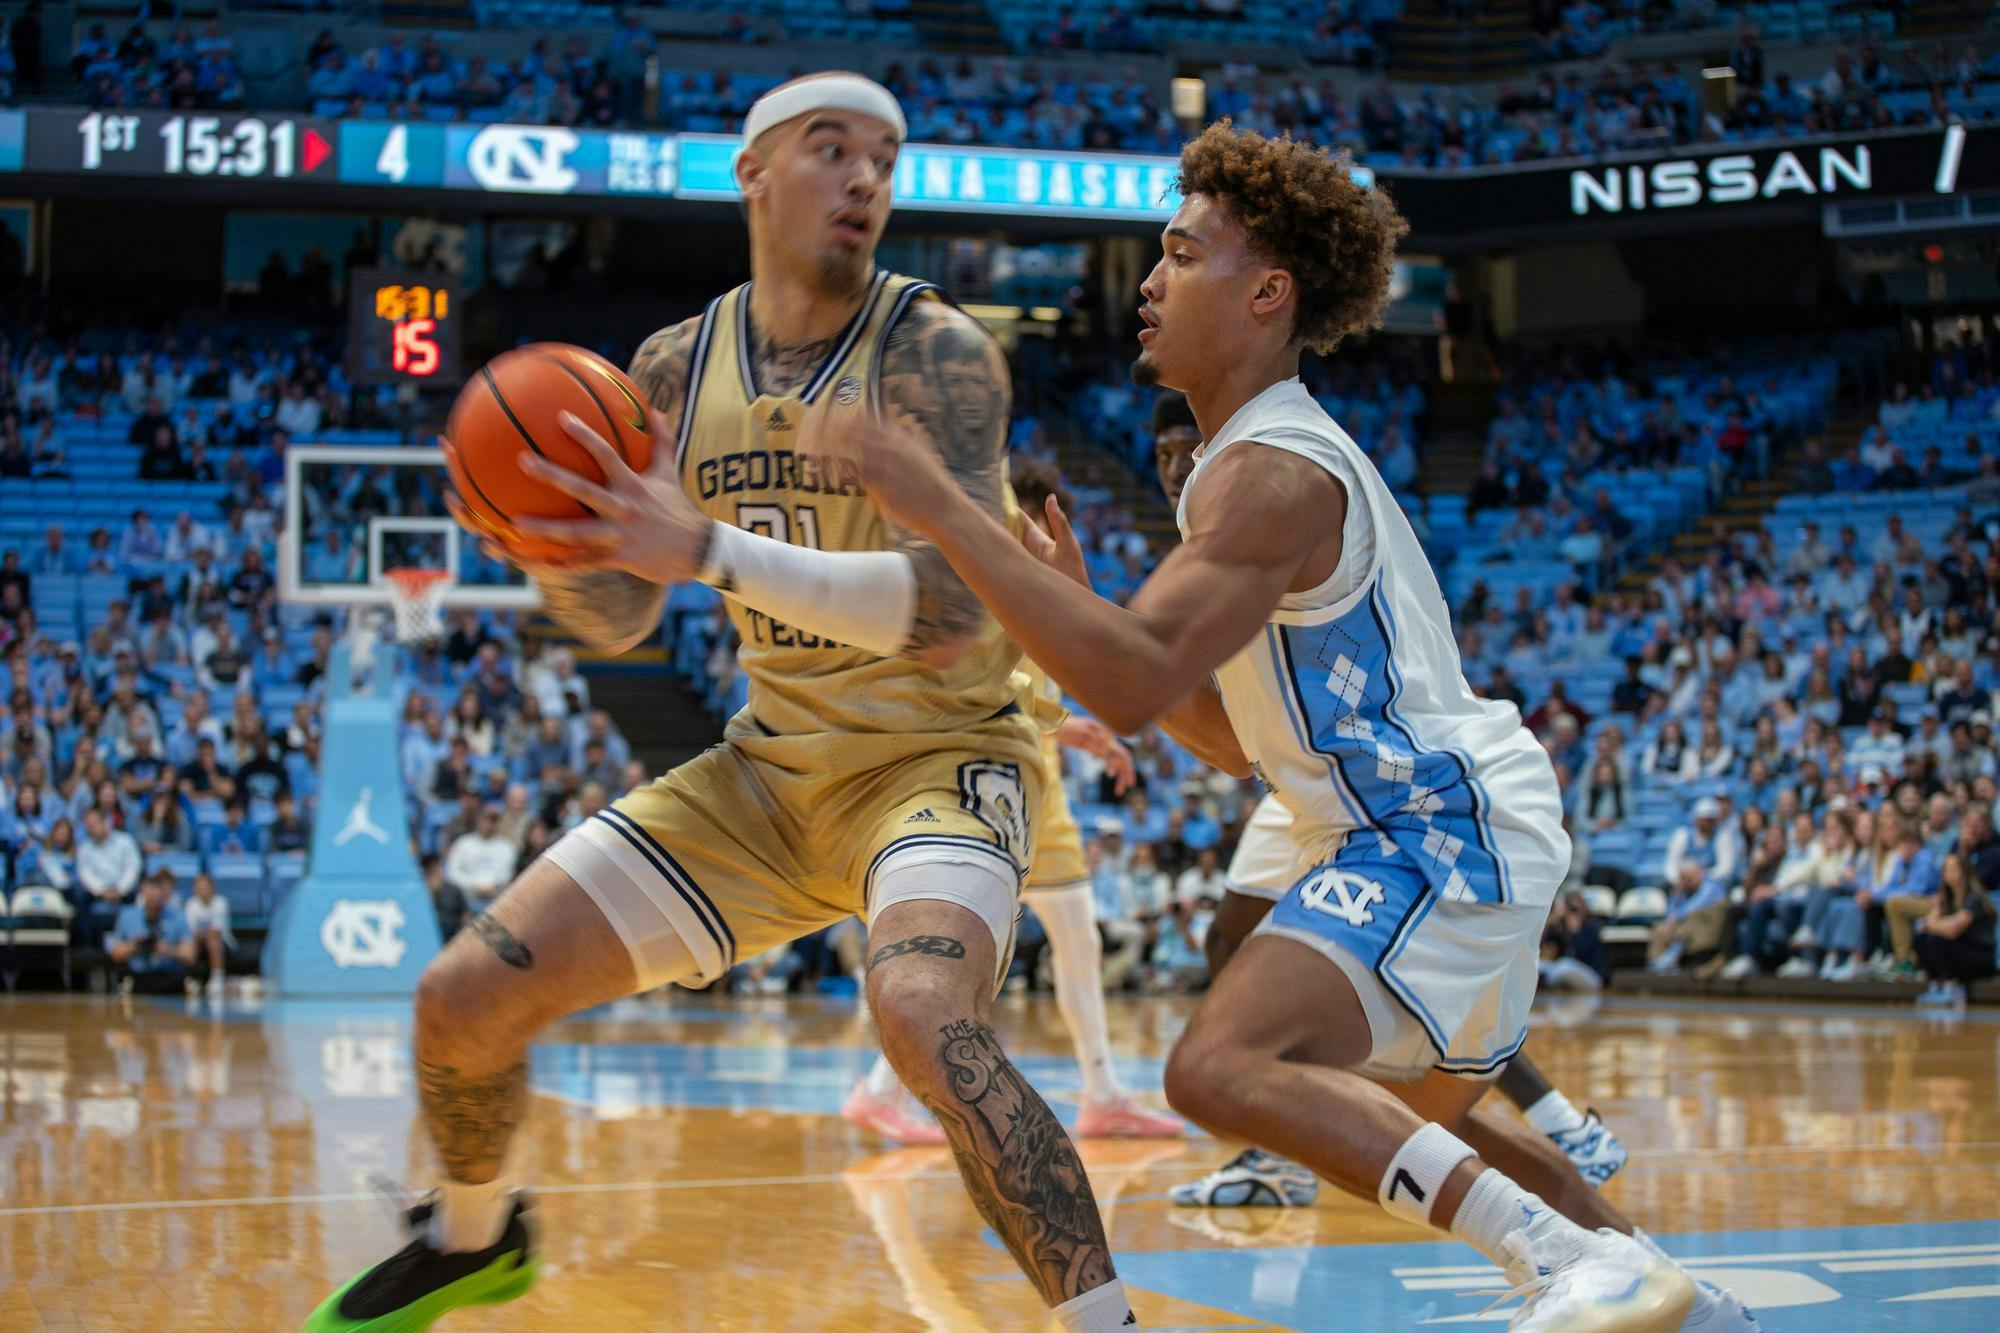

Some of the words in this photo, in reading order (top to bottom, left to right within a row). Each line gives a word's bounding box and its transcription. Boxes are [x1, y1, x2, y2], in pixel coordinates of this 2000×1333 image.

[78, 112, 141, 170] 1ST
[159, 115, 296, 178] 15:31
[376, 123, 409, 183] 4
[1015, 158, 1173, 208] BASKE
[1570, 144, 1872, 215] NISSAN
[393, 317, 440, 376] 15
[697, 450, 868, 500] GEORGIA
[939, 1018, 973, 1041] THE
[1388, 1167, 1426, 1203] 7
